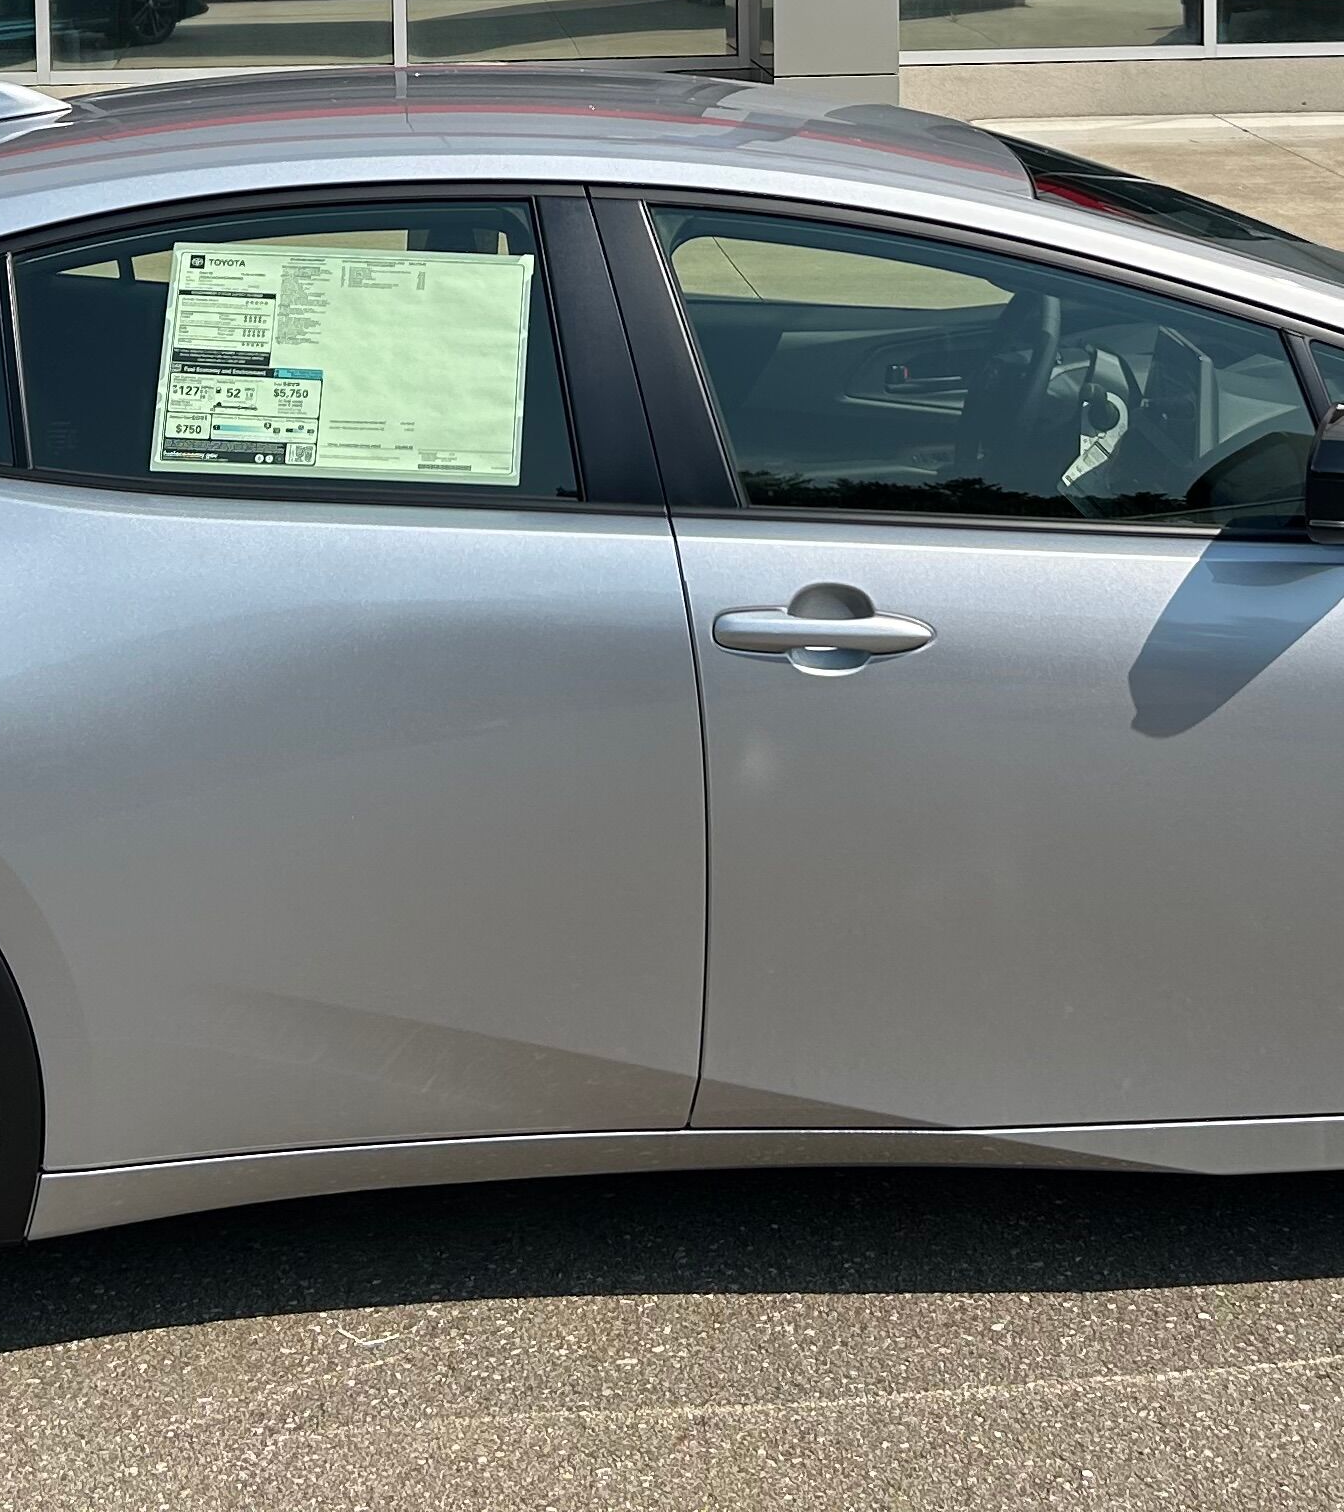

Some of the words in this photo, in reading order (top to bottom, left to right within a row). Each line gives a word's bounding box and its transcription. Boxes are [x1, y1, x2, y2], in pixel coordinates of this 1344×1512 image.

[208, 258, 246, 267] TOYOTA
[179, 385, 200, 396] 127
[226, 388, 241, 398] 52
[175, 423, 202, 434] $750
